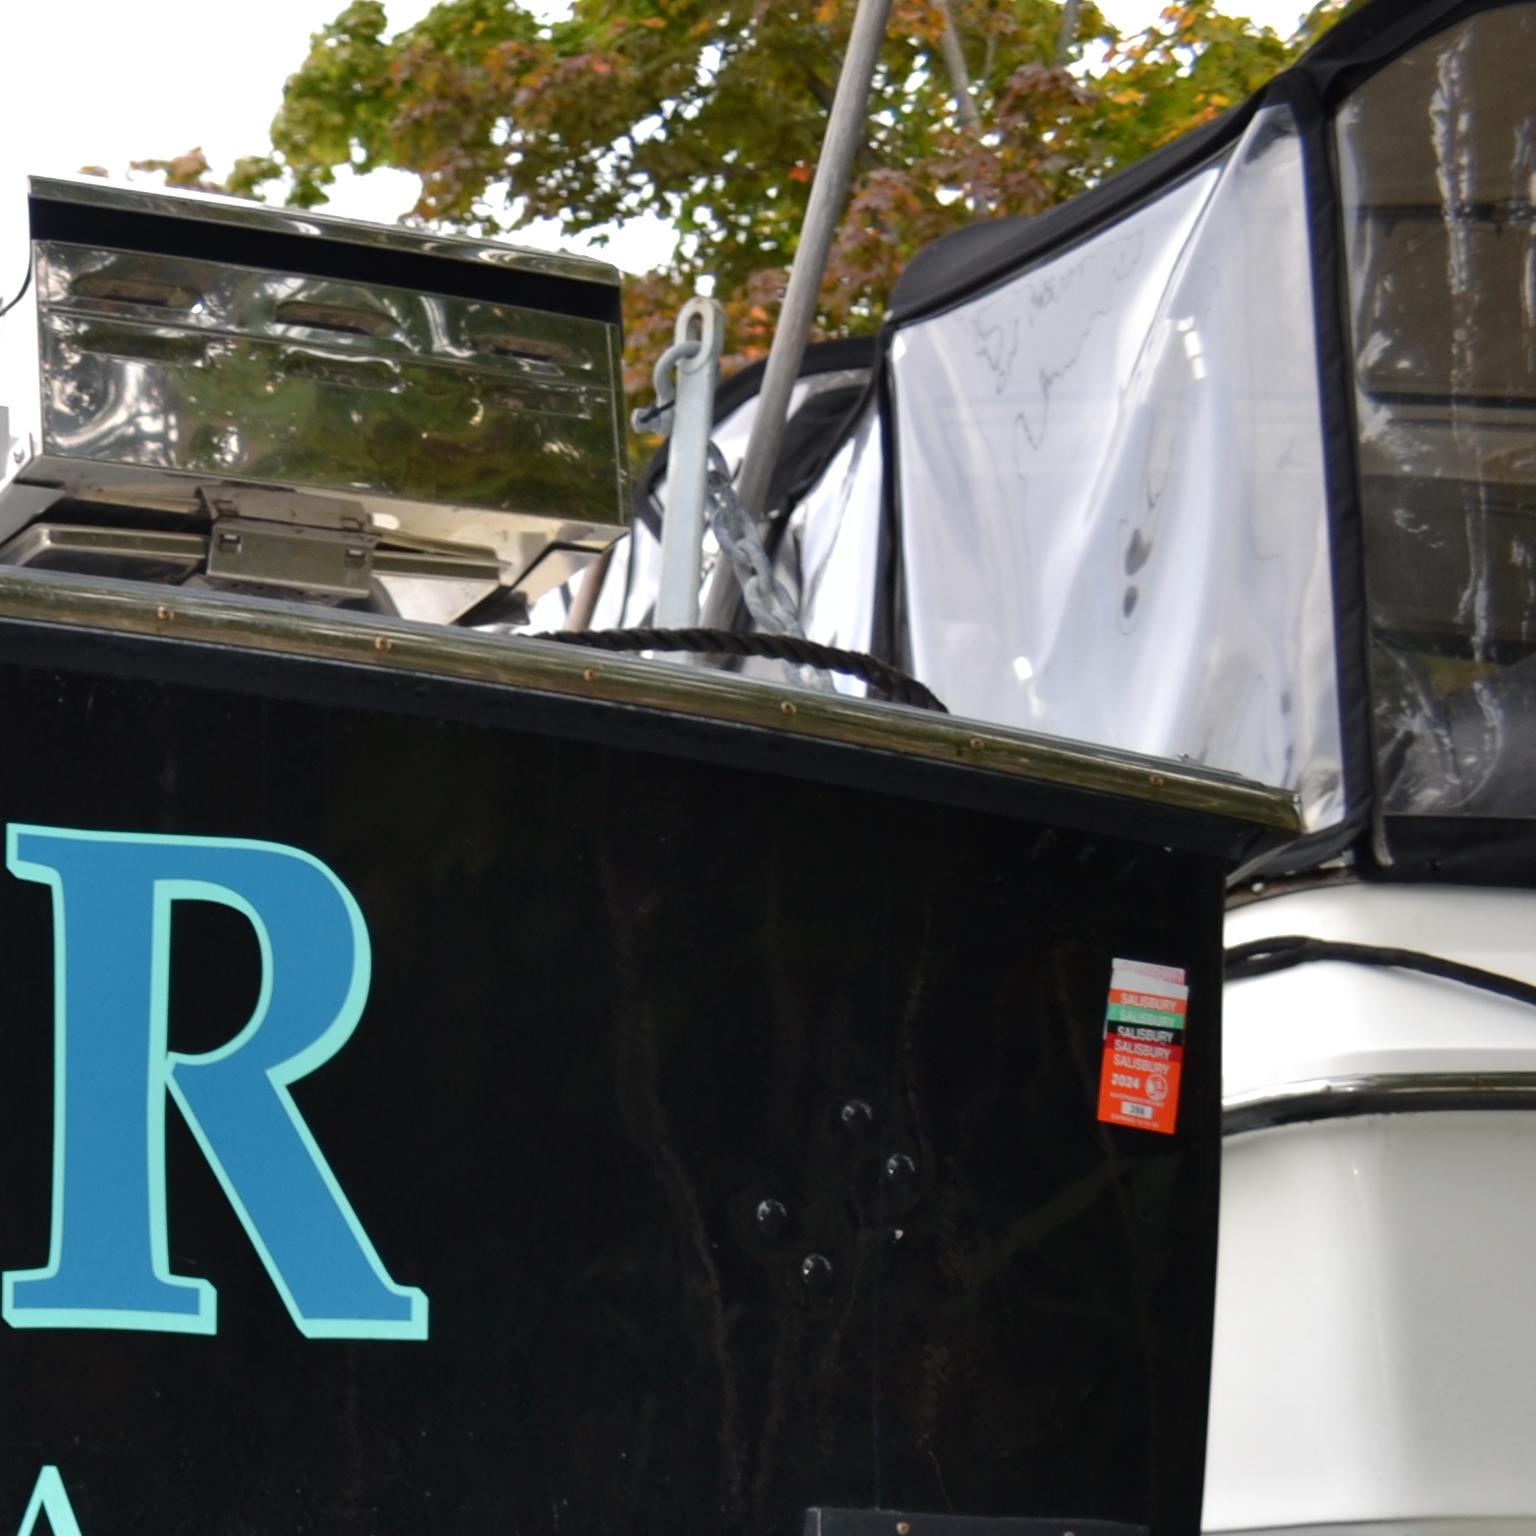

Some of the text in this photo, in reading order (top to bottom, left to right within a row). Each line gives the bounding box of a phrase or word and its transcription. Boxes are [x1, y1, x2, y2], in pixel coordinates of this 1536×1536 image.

[1119, 991, 1178, 1013] SALISBURY
[1118, 1008, 1176, 1028] SALISBURY
[1117, 1025, 1175, 1044] SALISBURY
[1114, 1039, 1172, 1060] SALISBURY
[1113, 1053, 1171, 1076] SALISBURY
